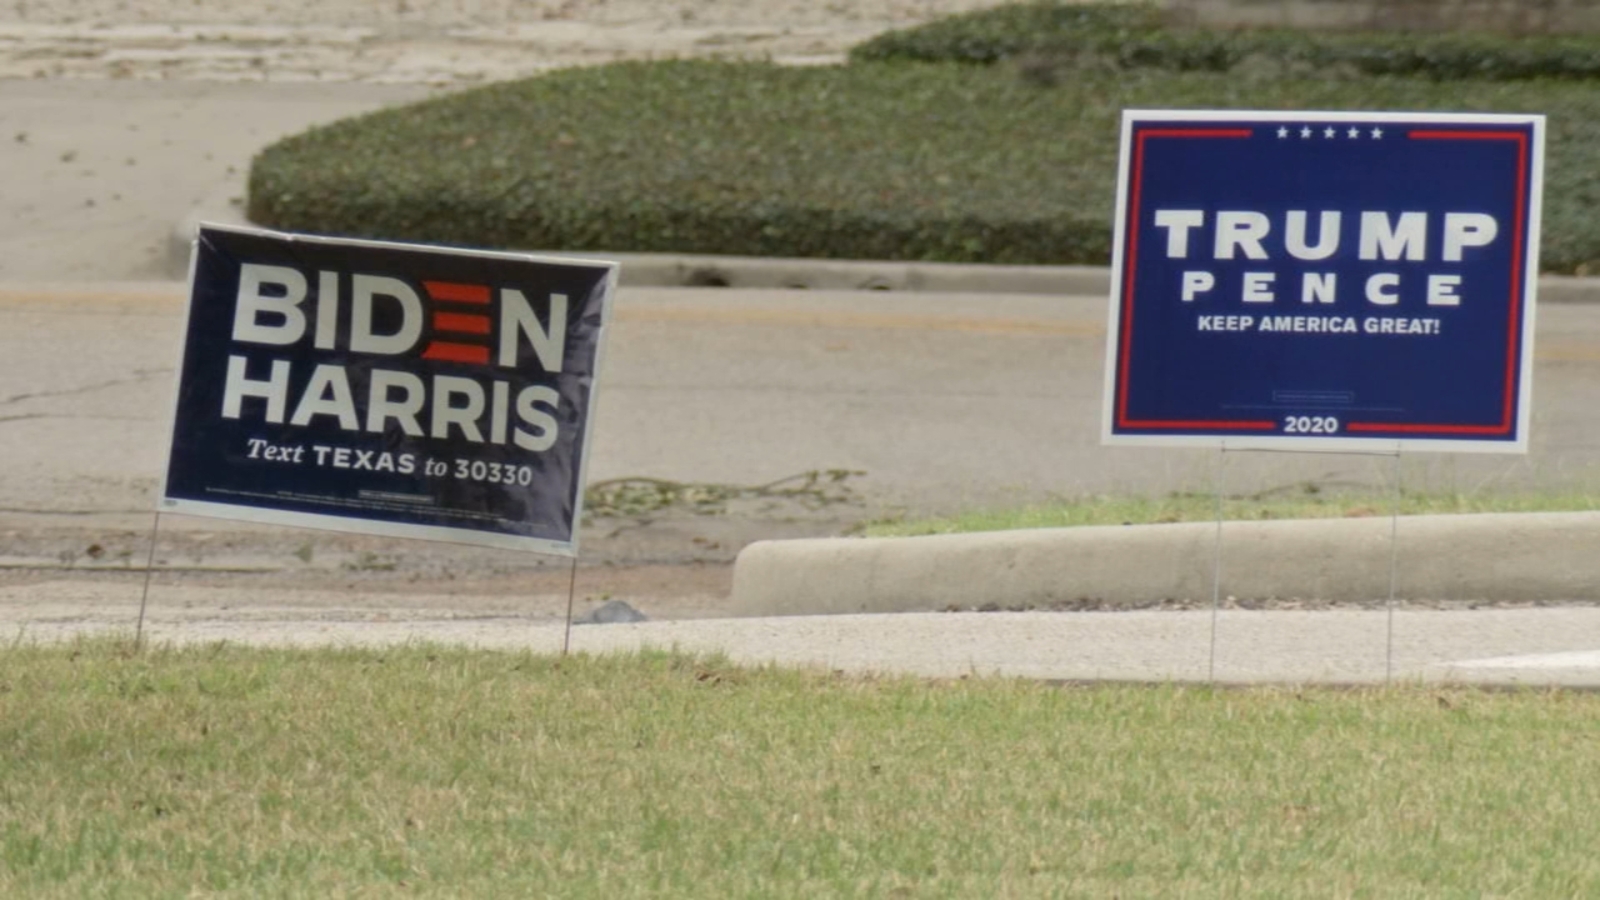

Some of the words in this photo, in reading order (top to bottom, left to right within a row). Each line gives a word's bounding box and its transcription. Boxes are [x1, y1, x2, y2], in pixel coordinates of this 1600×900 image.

[1154, 209, 1498, 261] TRUMP
[1181, 271, 1462, 305] PENCE
[231, 263, 567, 373] BIDEN
[1198, 315, 1253, 331] KEEP
[1259, 317, 1357, 333] AMERICA
[1364, 317, 1440, 334] GREAT!
[221, 355, 560, 452] HARRIS
[1283, 416, 1338, 433] 2020
[246, 438, 304, 465] Text
[312, 445, 415, 474] TEXAS
[424, 458, 447, 477] to
[454, 460, 532, 486] 30330
